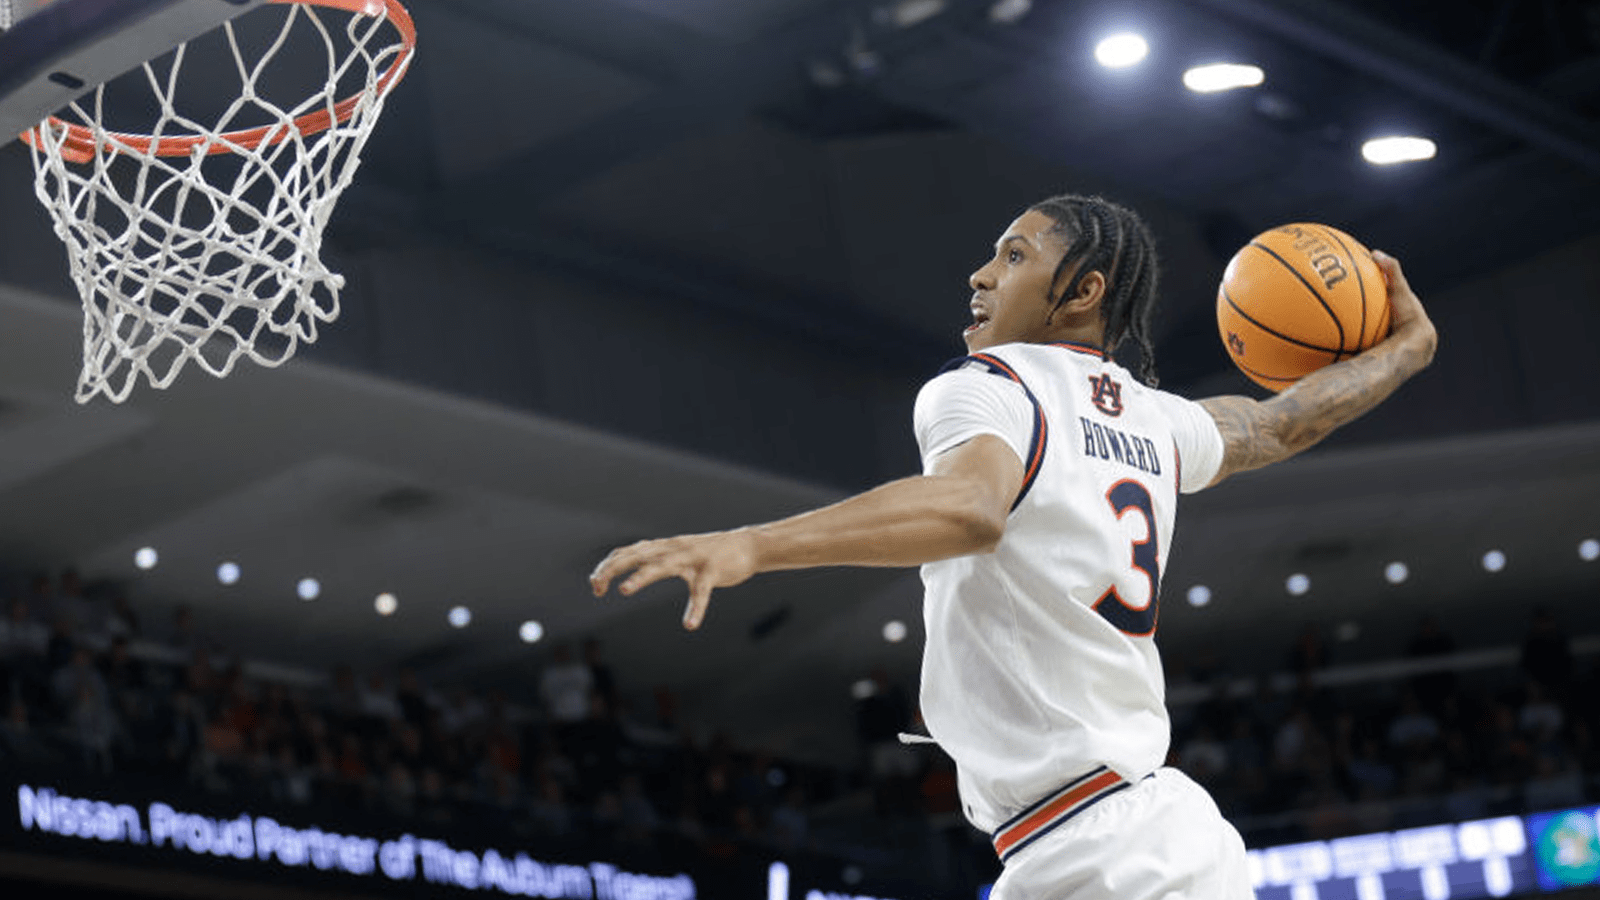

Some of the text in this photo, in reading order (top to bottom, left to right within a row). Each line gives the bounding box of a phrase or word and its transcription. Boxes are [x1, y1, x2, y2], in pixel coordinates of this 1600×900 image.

[1079, 416, 1161, 476] HOWARD
[1090, 478, 1160, 637] 3
[149, 802, 254, 859] Proud
[254, 816, 377, 874] Partner
[378, 833, 418, 880] of
[418, 838, 480, 889] The
[480, 849, 592, 899] Auburn
